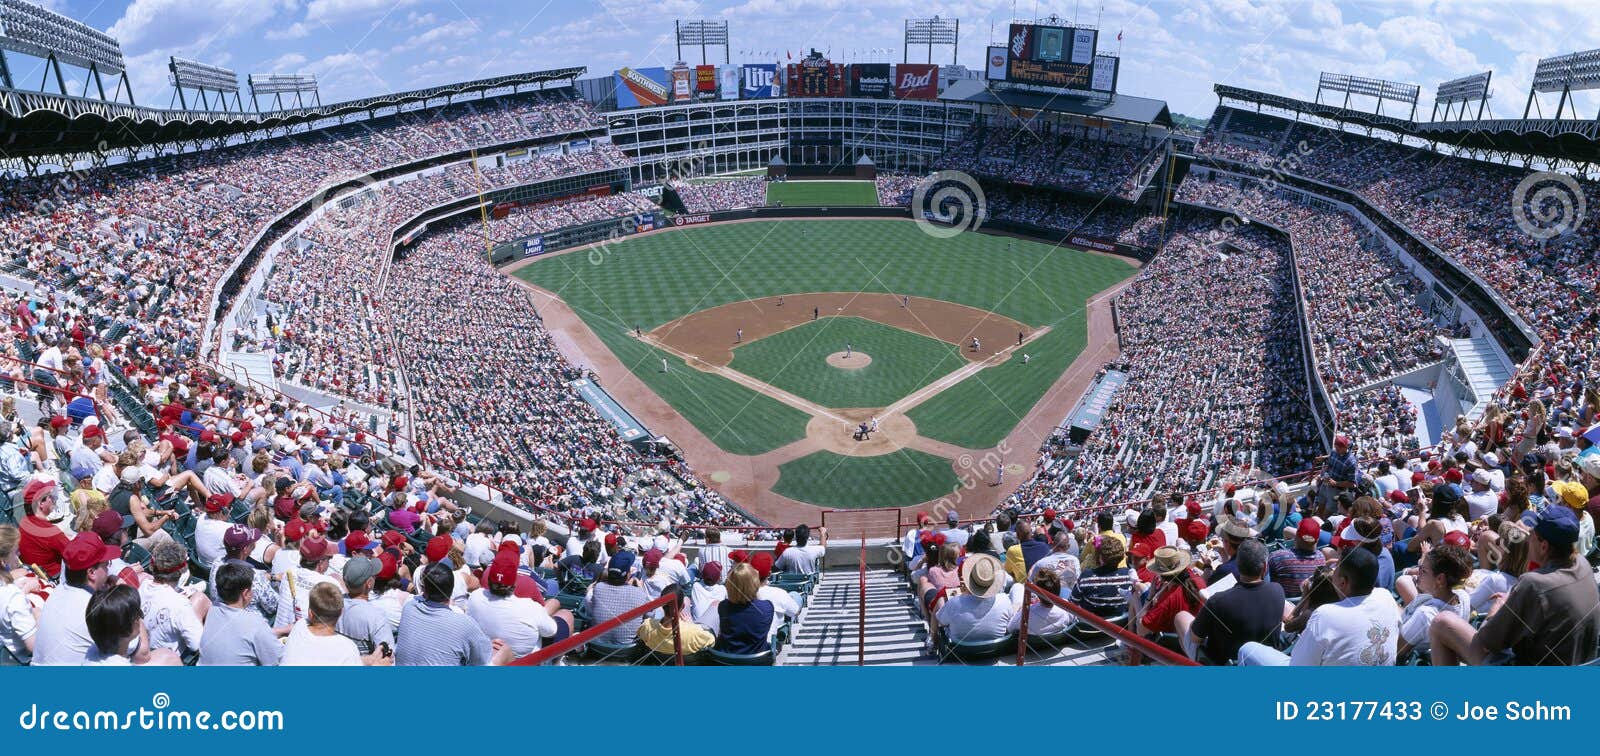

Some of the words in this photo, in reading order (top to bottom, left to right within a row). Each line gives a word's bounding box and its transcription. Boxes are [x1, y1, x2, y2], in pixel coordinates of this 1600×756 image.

[626, 70, 666, 96] SOUTHWEST
[745, 67, 774, 91] Lite
[899, 69, 932, 89] Bud
[632, 185, 665, 198] ARGET
[684, 215, 711, 224] TARGET
[527, 237, 540, 247] BUD
[525, 245, 543, 255] LIGHT
[496, 573, 504, 582] T
